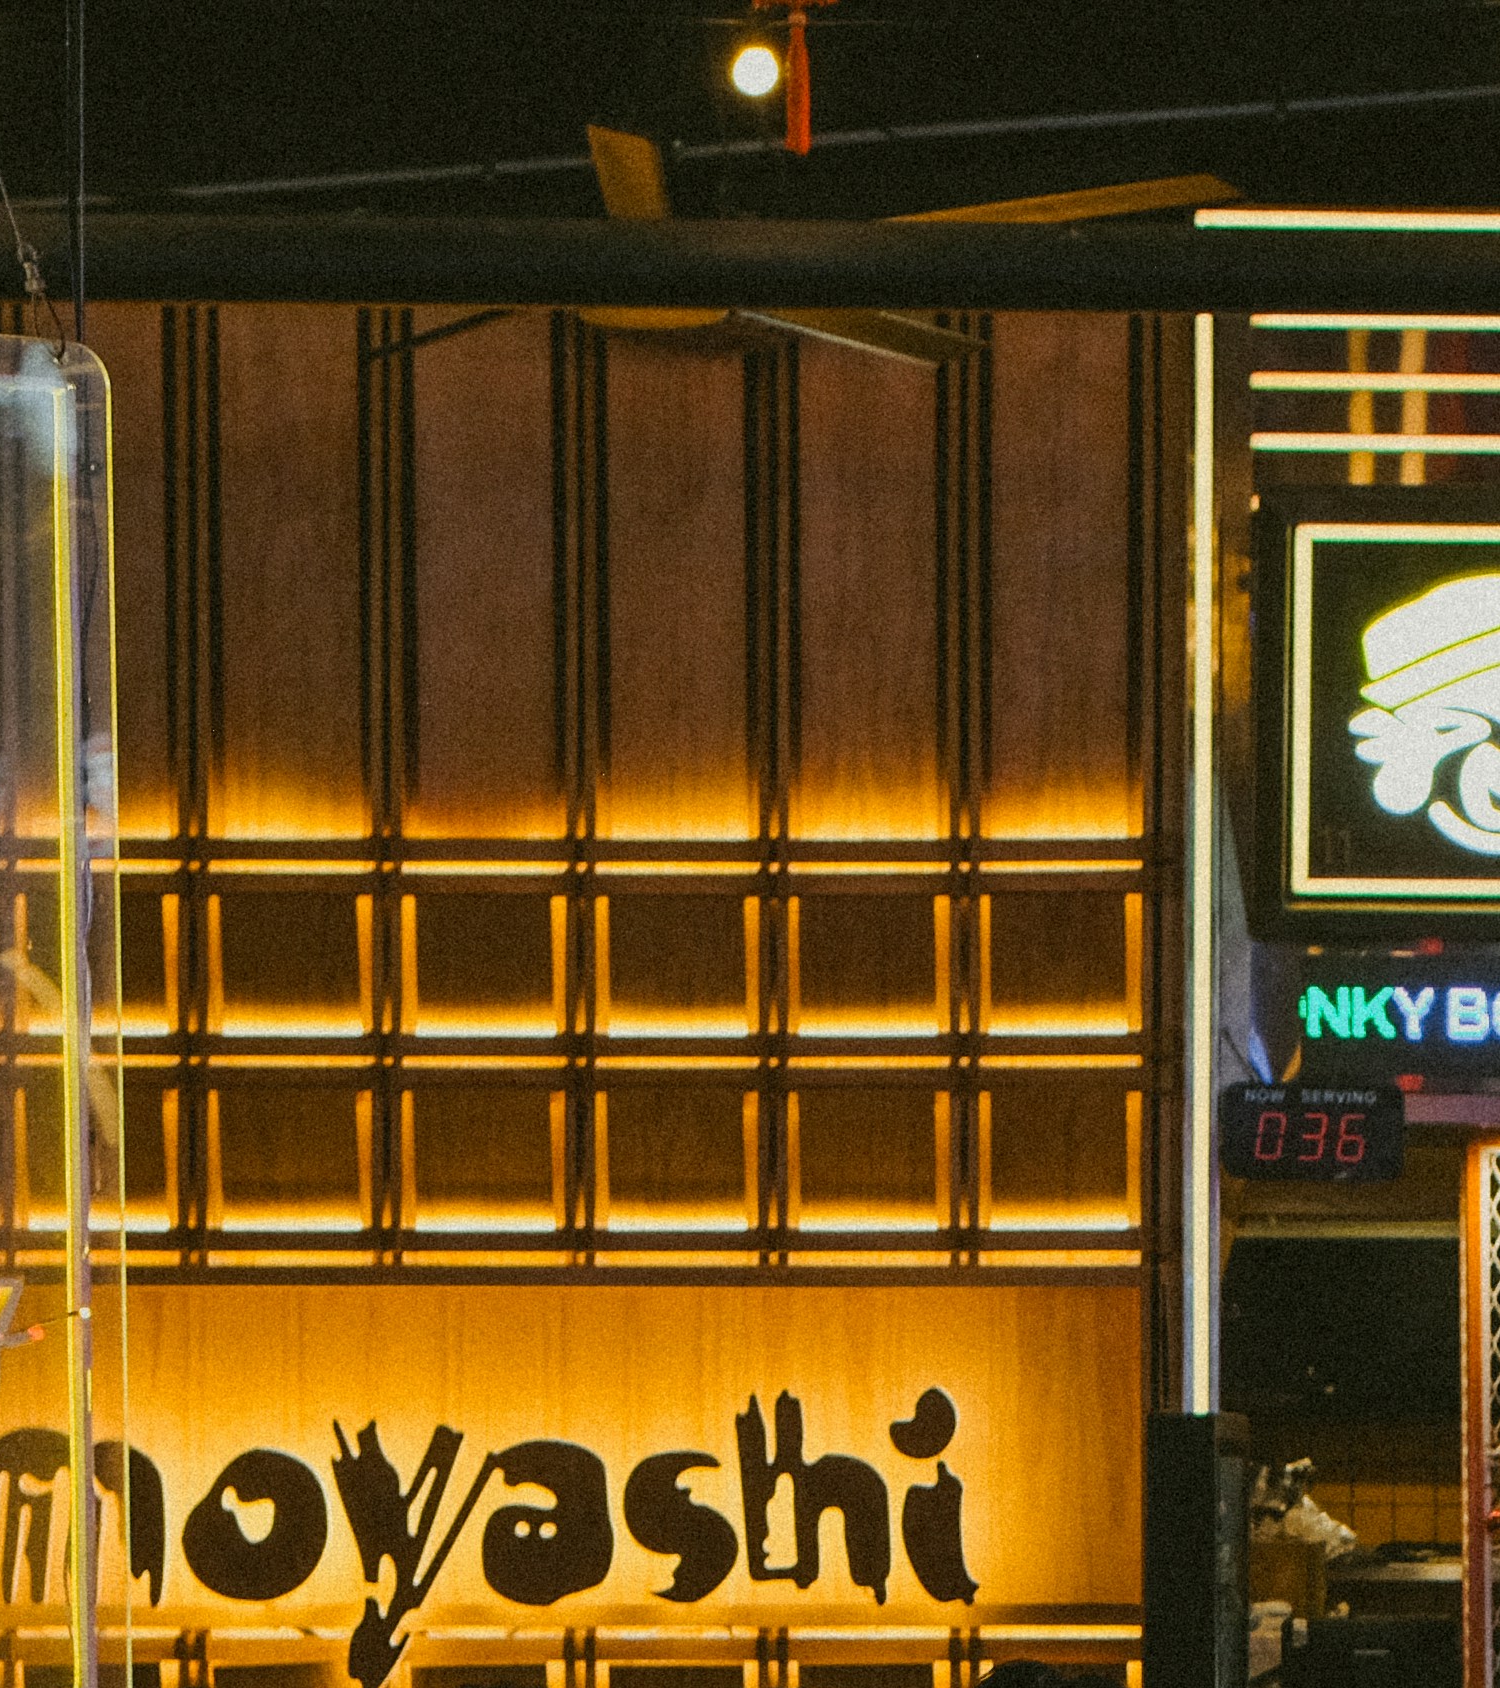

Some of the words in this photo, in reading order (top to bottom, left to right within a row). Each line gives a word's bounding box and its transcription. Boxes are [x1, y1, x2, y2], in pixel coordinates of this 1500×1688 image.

[1302, 986, 1436, 1041] NKY
[1300, 1088, 1377, 1105] SERVING
[1254, 1110, 1366, 1164] 036
